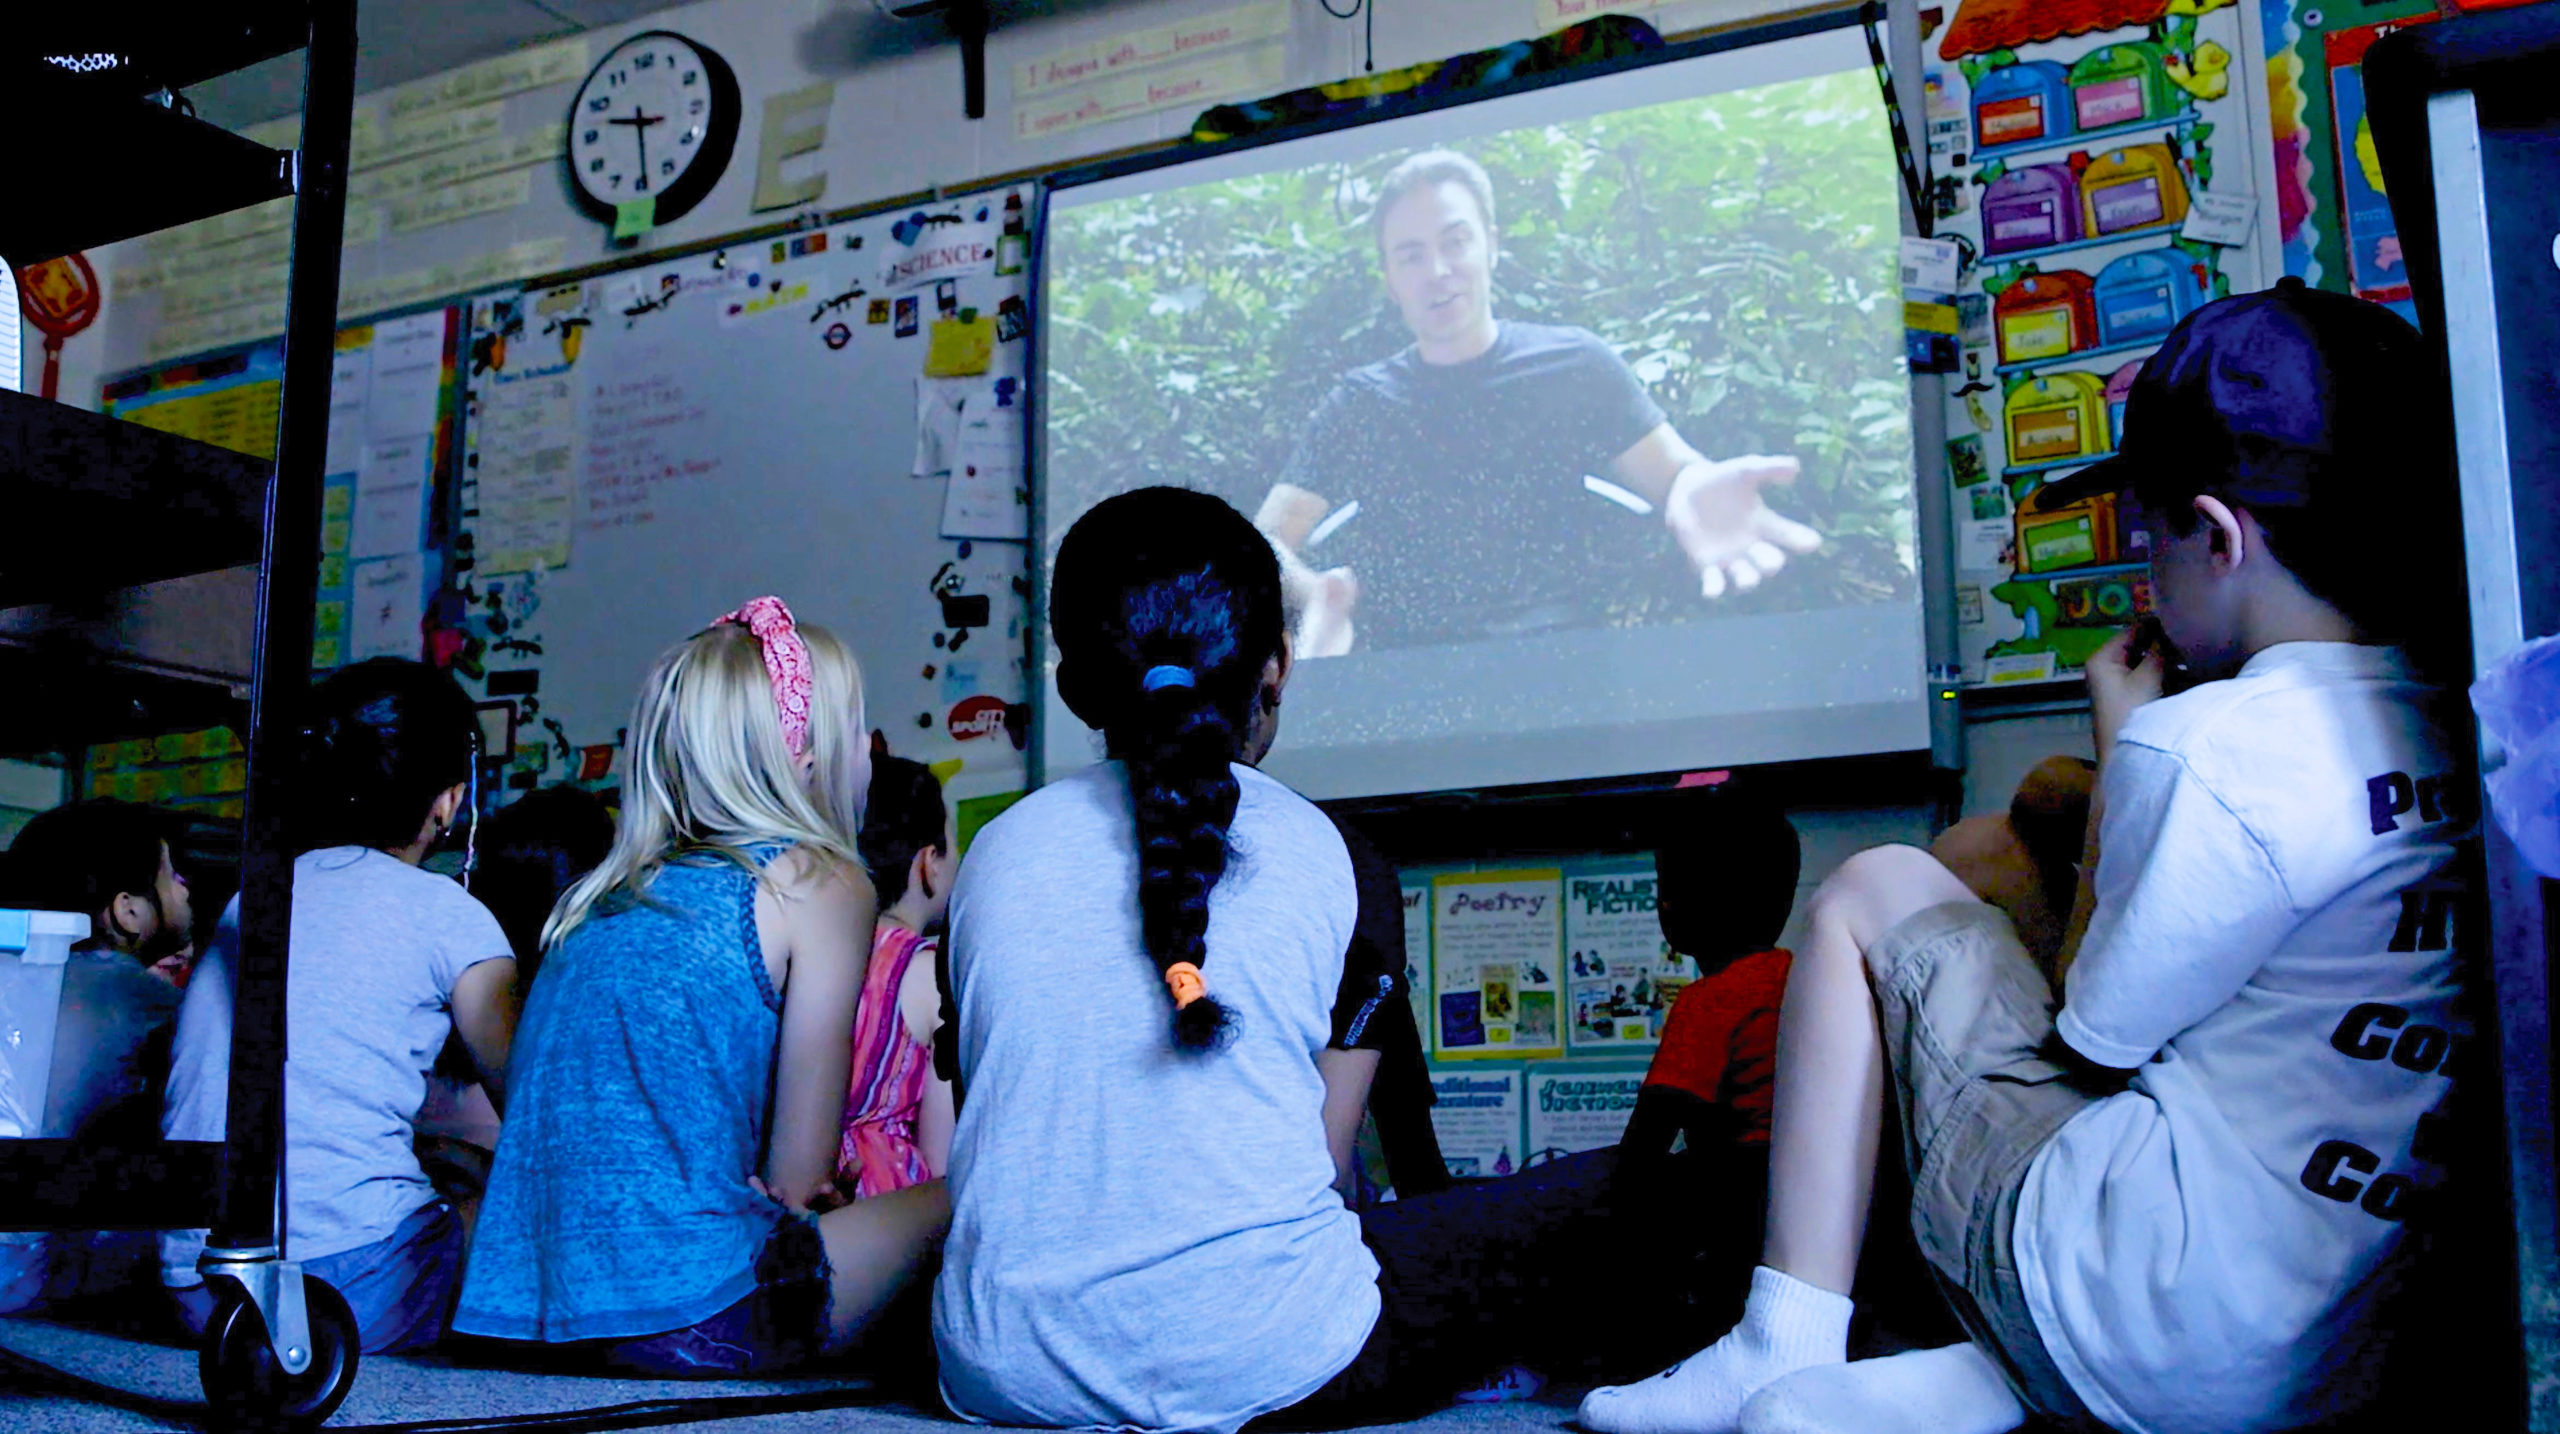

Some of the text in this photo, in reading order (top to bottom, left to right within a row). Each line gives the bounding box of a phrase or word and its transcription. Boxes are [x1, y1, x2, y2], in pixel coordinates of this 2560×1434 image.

[635, 54, 655, 70] 12
[665, 54, 676, 69] 1
[609, 71, 627, 88] 11
[683, 71, 697, 86] 2
[589, 96, 611, 112] 10
[584, 129, 599, 146] 9
[590, 158, 604, 173] 8
[662, 159, 675, 175] 5
[609, 175, 622, 190] 7
[898, 242, 985, 276] SCIENCE
[1449, 891, 1546, 916] Poetry
[1586, 896, 1658, 914] FICTIO
